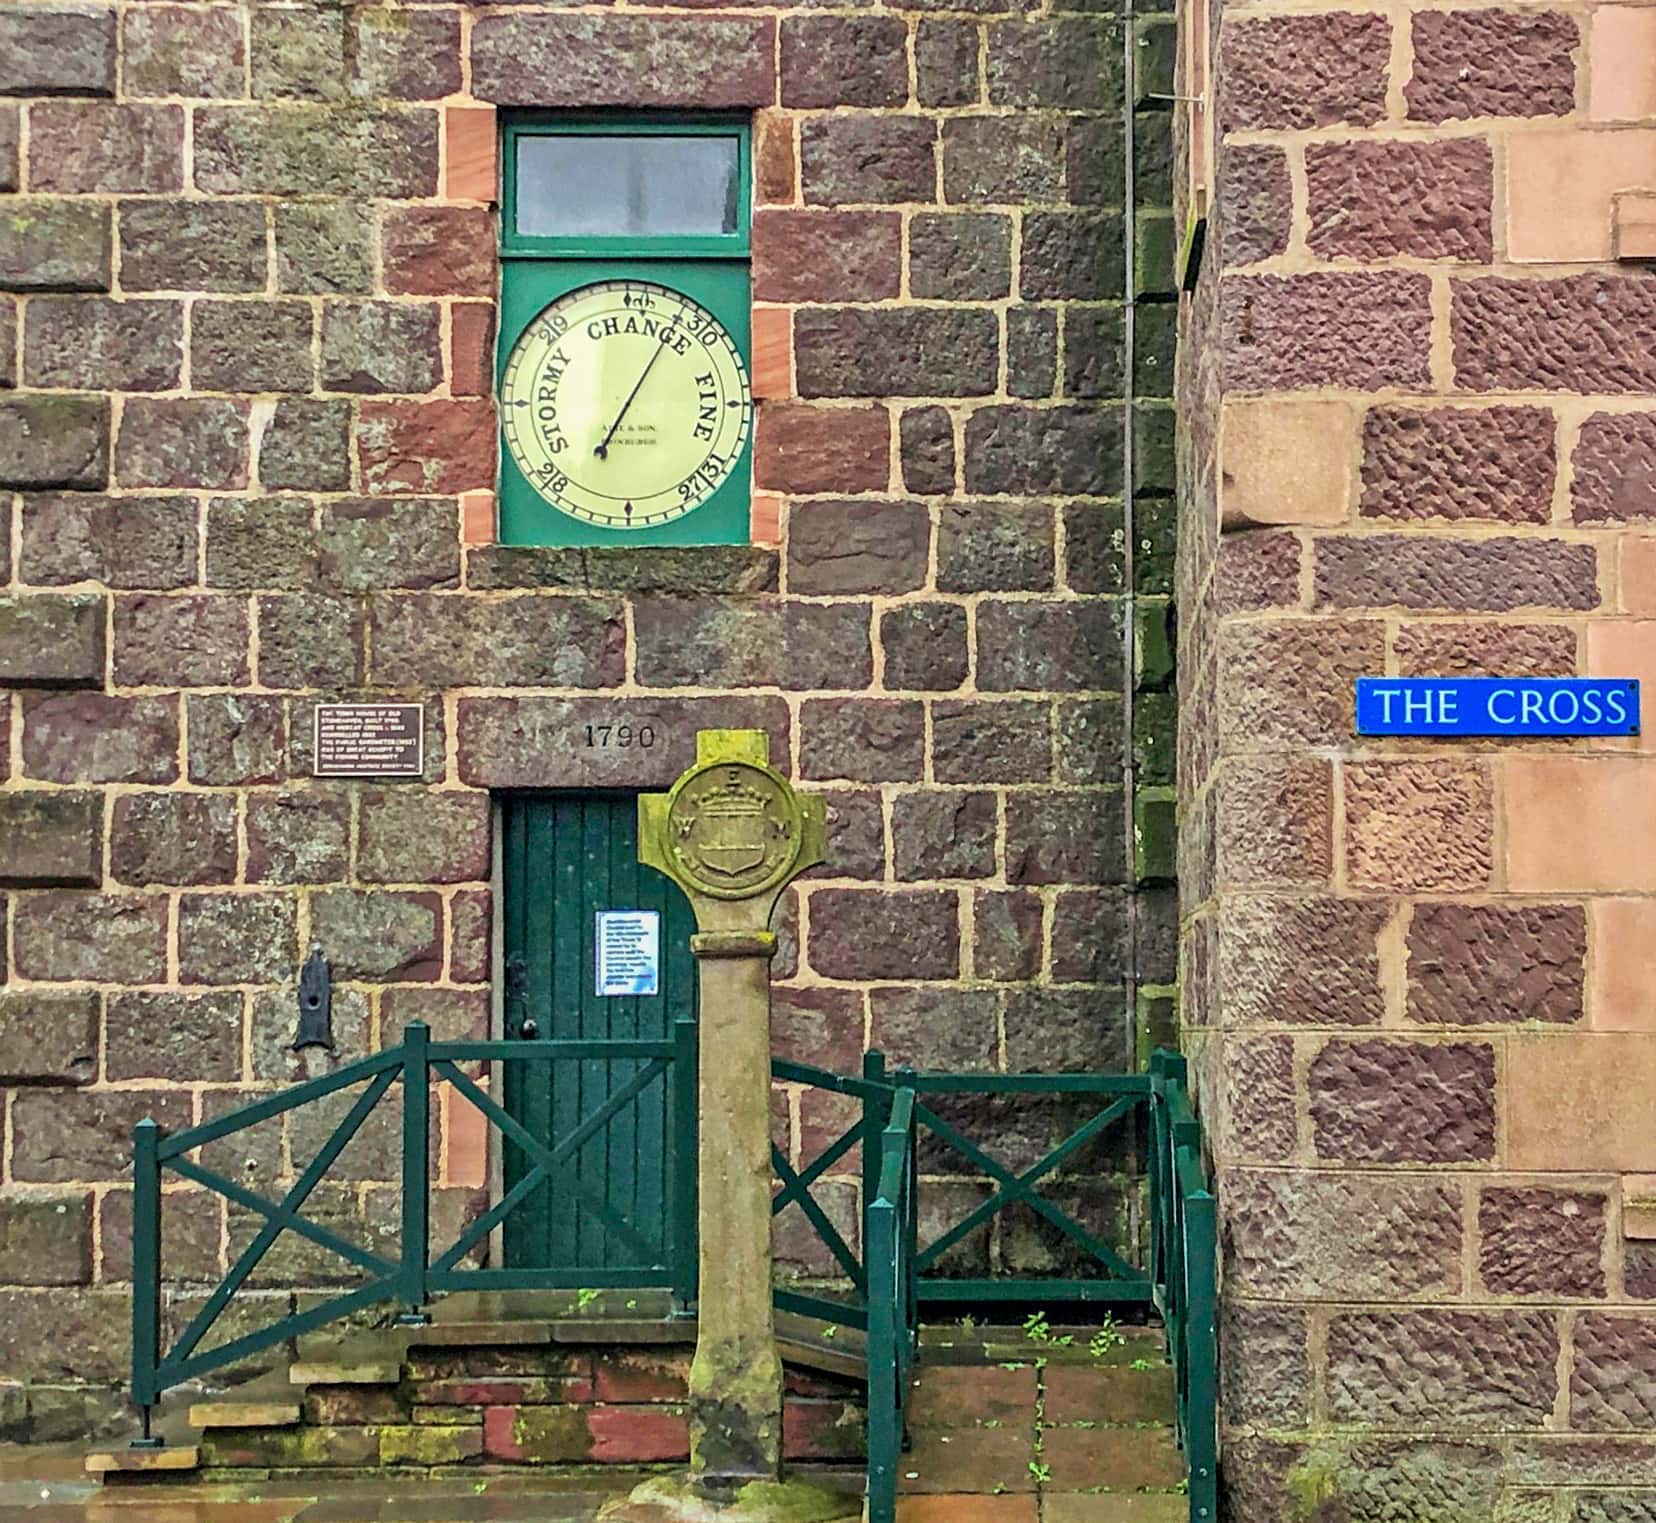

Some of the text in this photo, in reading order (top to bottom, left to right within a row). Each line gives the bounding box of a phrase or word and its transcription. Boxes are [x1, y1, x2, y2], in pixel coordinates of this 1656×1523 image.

[538, 314, 569, 346] 29
[587, 317, 693, 356] CHANGE
[686, 313, 718, 347] 30
[538, 347, 572, 455] STORMY
[693, 370, 718, 443] FINE
[536, 462, 568, 493] 28
[1372, 689, 1627, 725] THE CROSS
[585, 725, 655, 748] 1790
